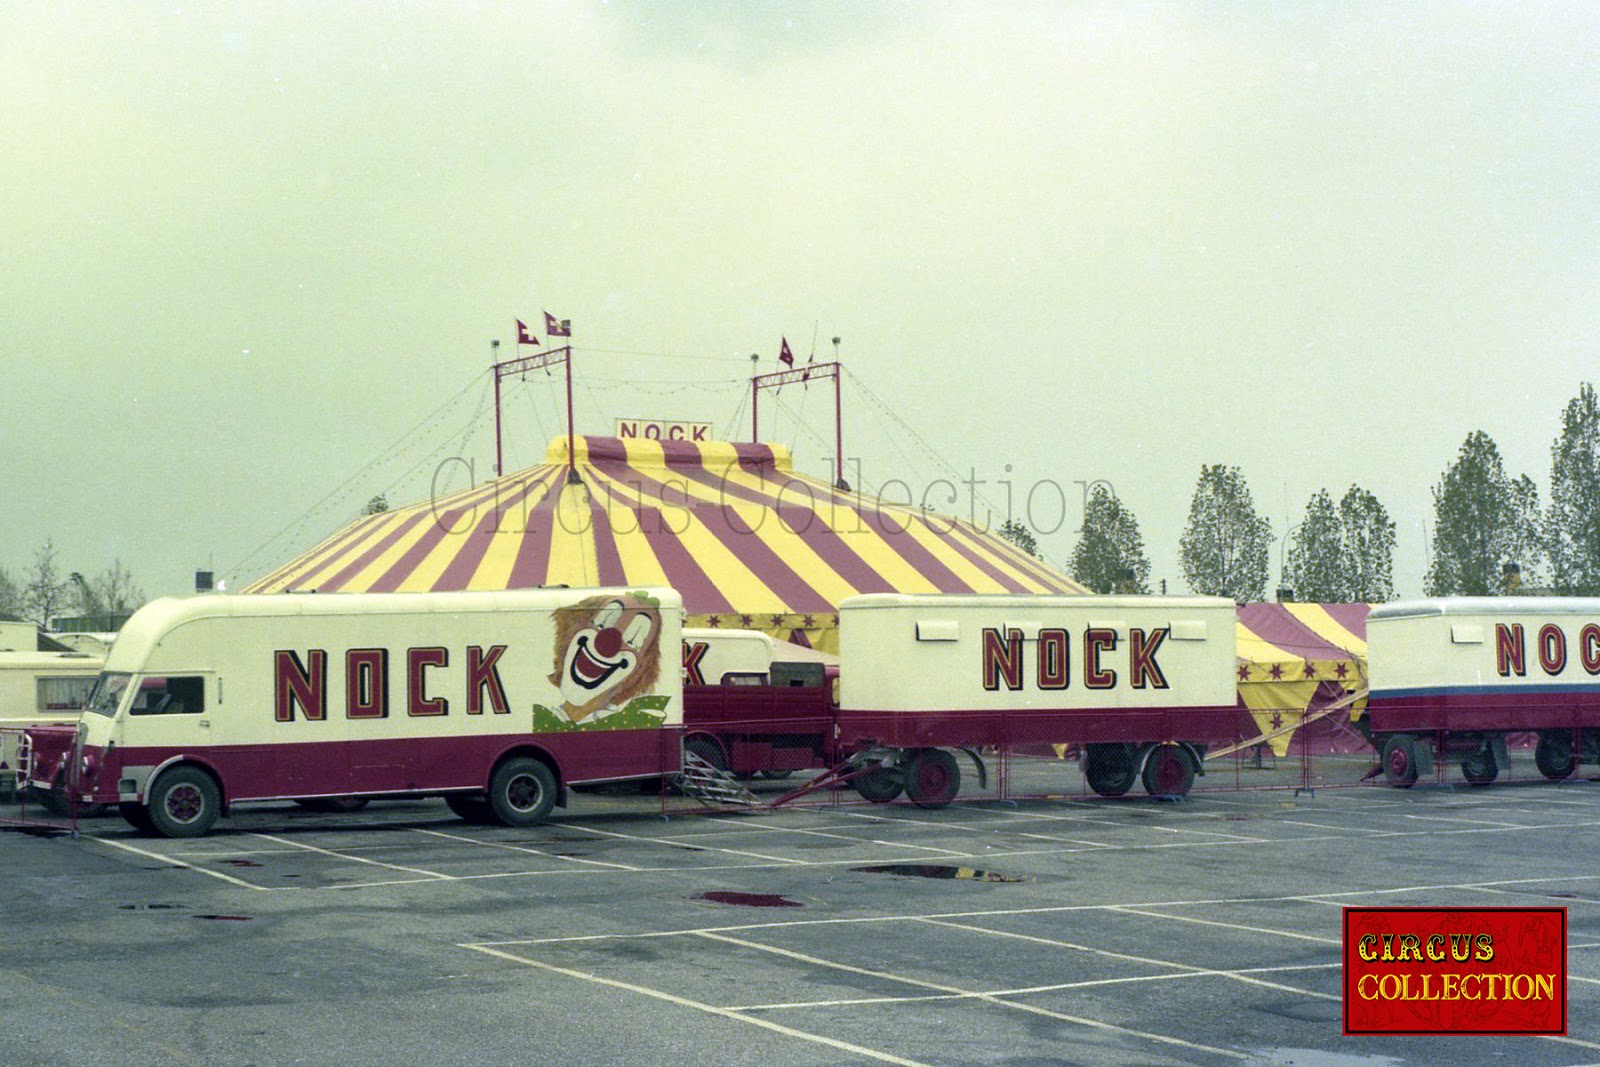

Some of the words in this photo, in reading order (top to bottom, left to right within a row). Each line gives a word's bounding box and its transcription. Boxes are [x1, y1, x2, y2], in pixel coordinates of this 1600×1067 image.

[621, 422, 708, 441] NOCK
[273, 644, 512, 723] NOCK
[982, 628, 1171, 691] NOCK
